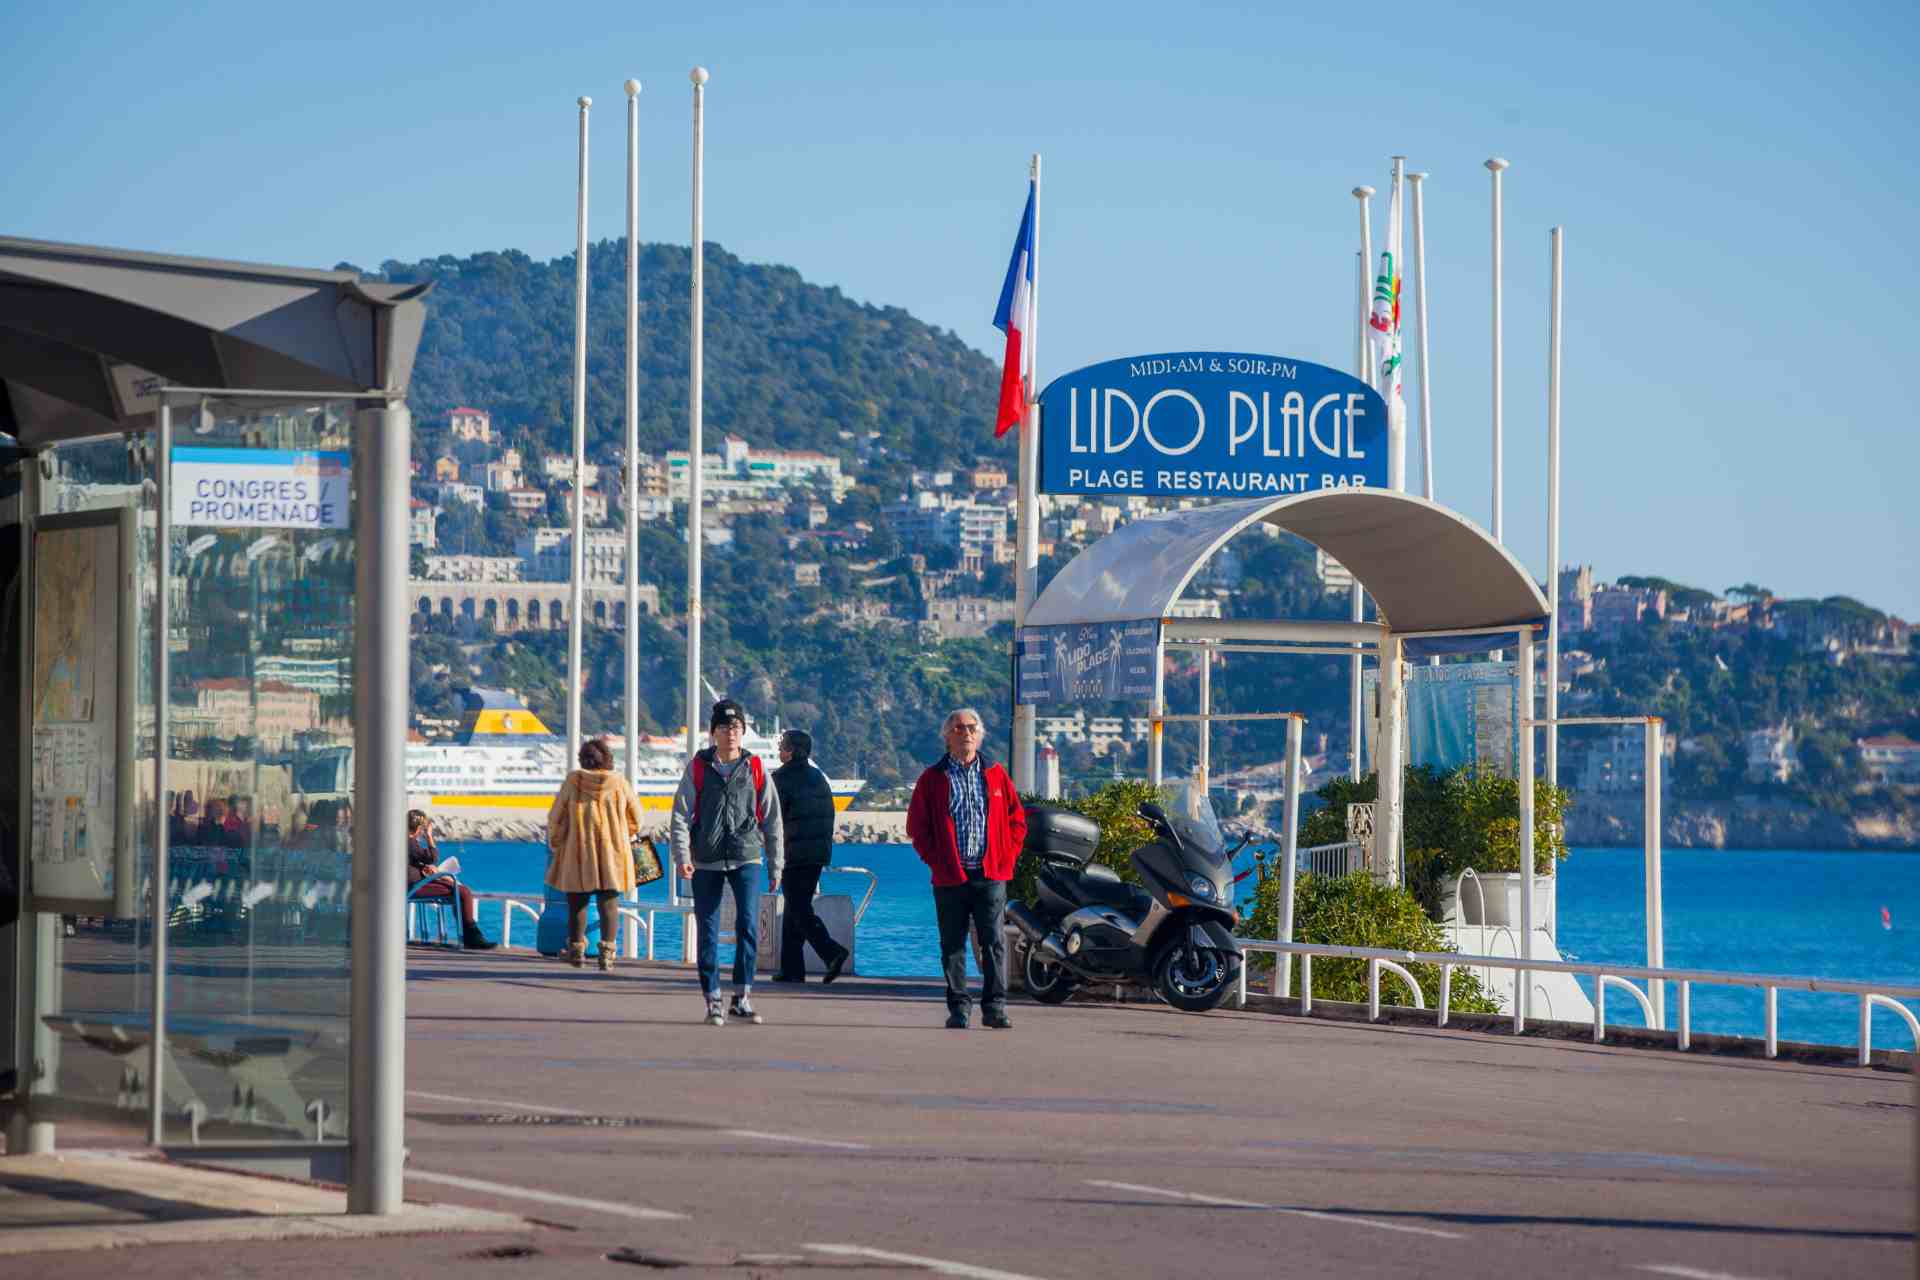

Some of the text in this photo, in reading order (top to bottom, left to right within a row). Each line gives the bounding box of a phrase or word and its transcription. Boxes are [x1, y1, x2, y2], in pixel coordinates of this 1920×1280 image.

[1130, 358, 1297, 379] MIDI-AM & SOIR-PM
[1070, 387, 1366, 459] LIDO PLAGE
[197, 479, 330, 502] CONGRES /
[1069, 469, 1367, 492] PLAGE RESTAURANT BAR
[191, 501, 335, 523] PROMENADE
[1067, 643, 1090, 665] LIDO
